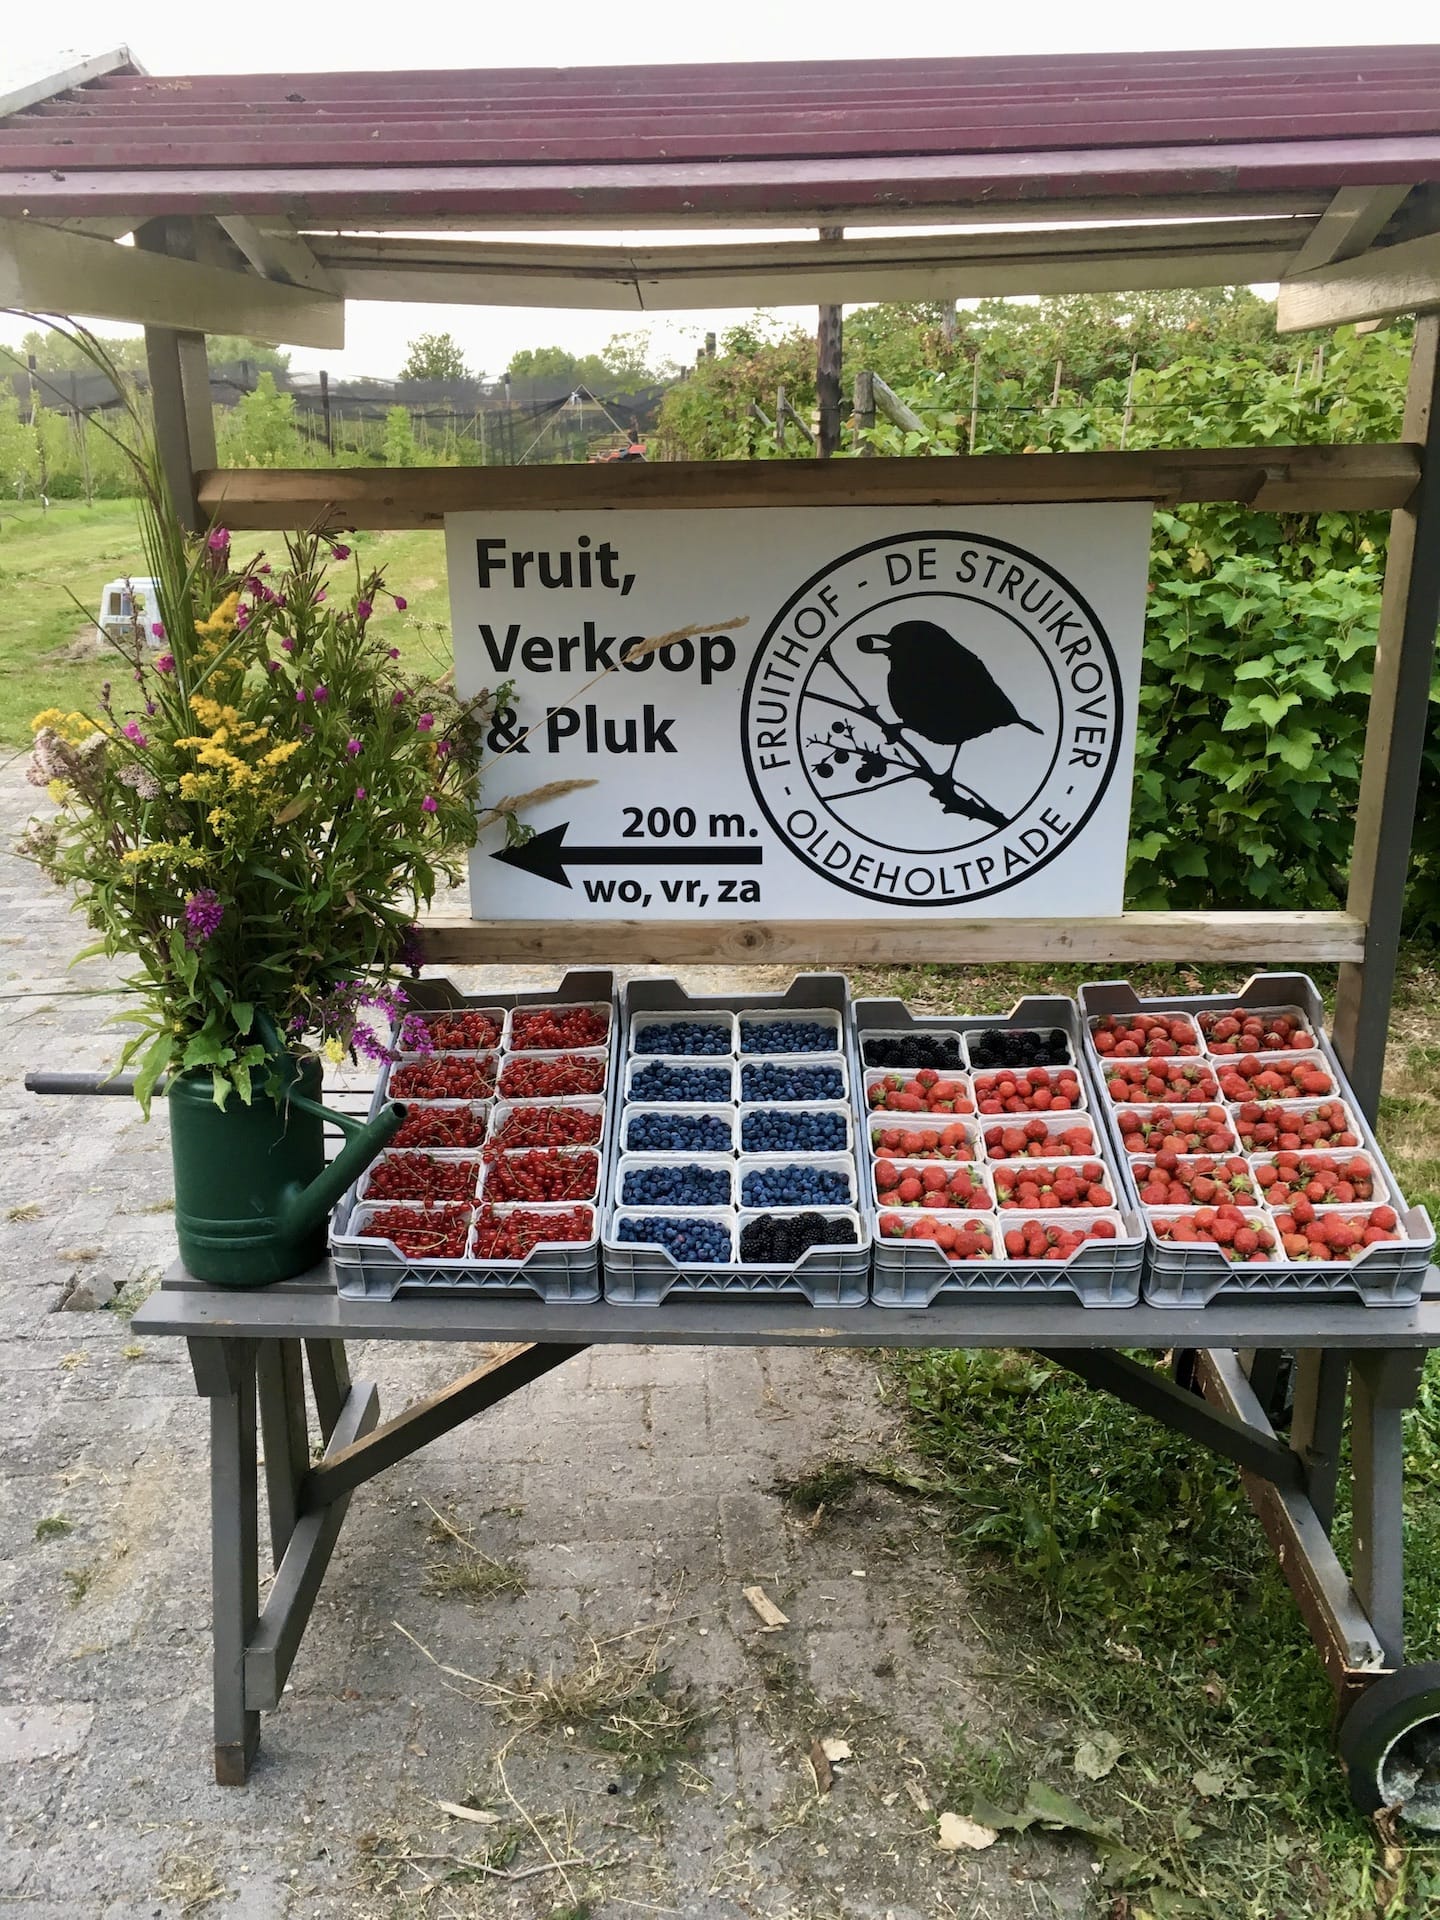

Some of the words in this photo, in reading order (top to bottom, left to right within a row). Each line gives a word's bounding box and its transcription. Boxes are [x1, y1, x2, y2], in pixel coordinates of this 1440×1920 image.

[476, 535, 636, 596] Fruit,
[478, 621, 736, 685] Verkoop
[757, 585, 841, 770] FRUITHOF
[885, 548, 937, 586] DE
[955, 550, 1108, 769] STRUIKROVER
[486, 706, 531, 754] &
[547, 704, 678, 753] Pluk
[621, 806, 697, 838] 200
[708, 812, 759, 838] m.
[787, 807, 1072, 896] OLDEHOLTPADE
[582, 879, 653, 908] wo,
[659, 879, 709, 908] vr,
[717, 879, 761, 903] za
